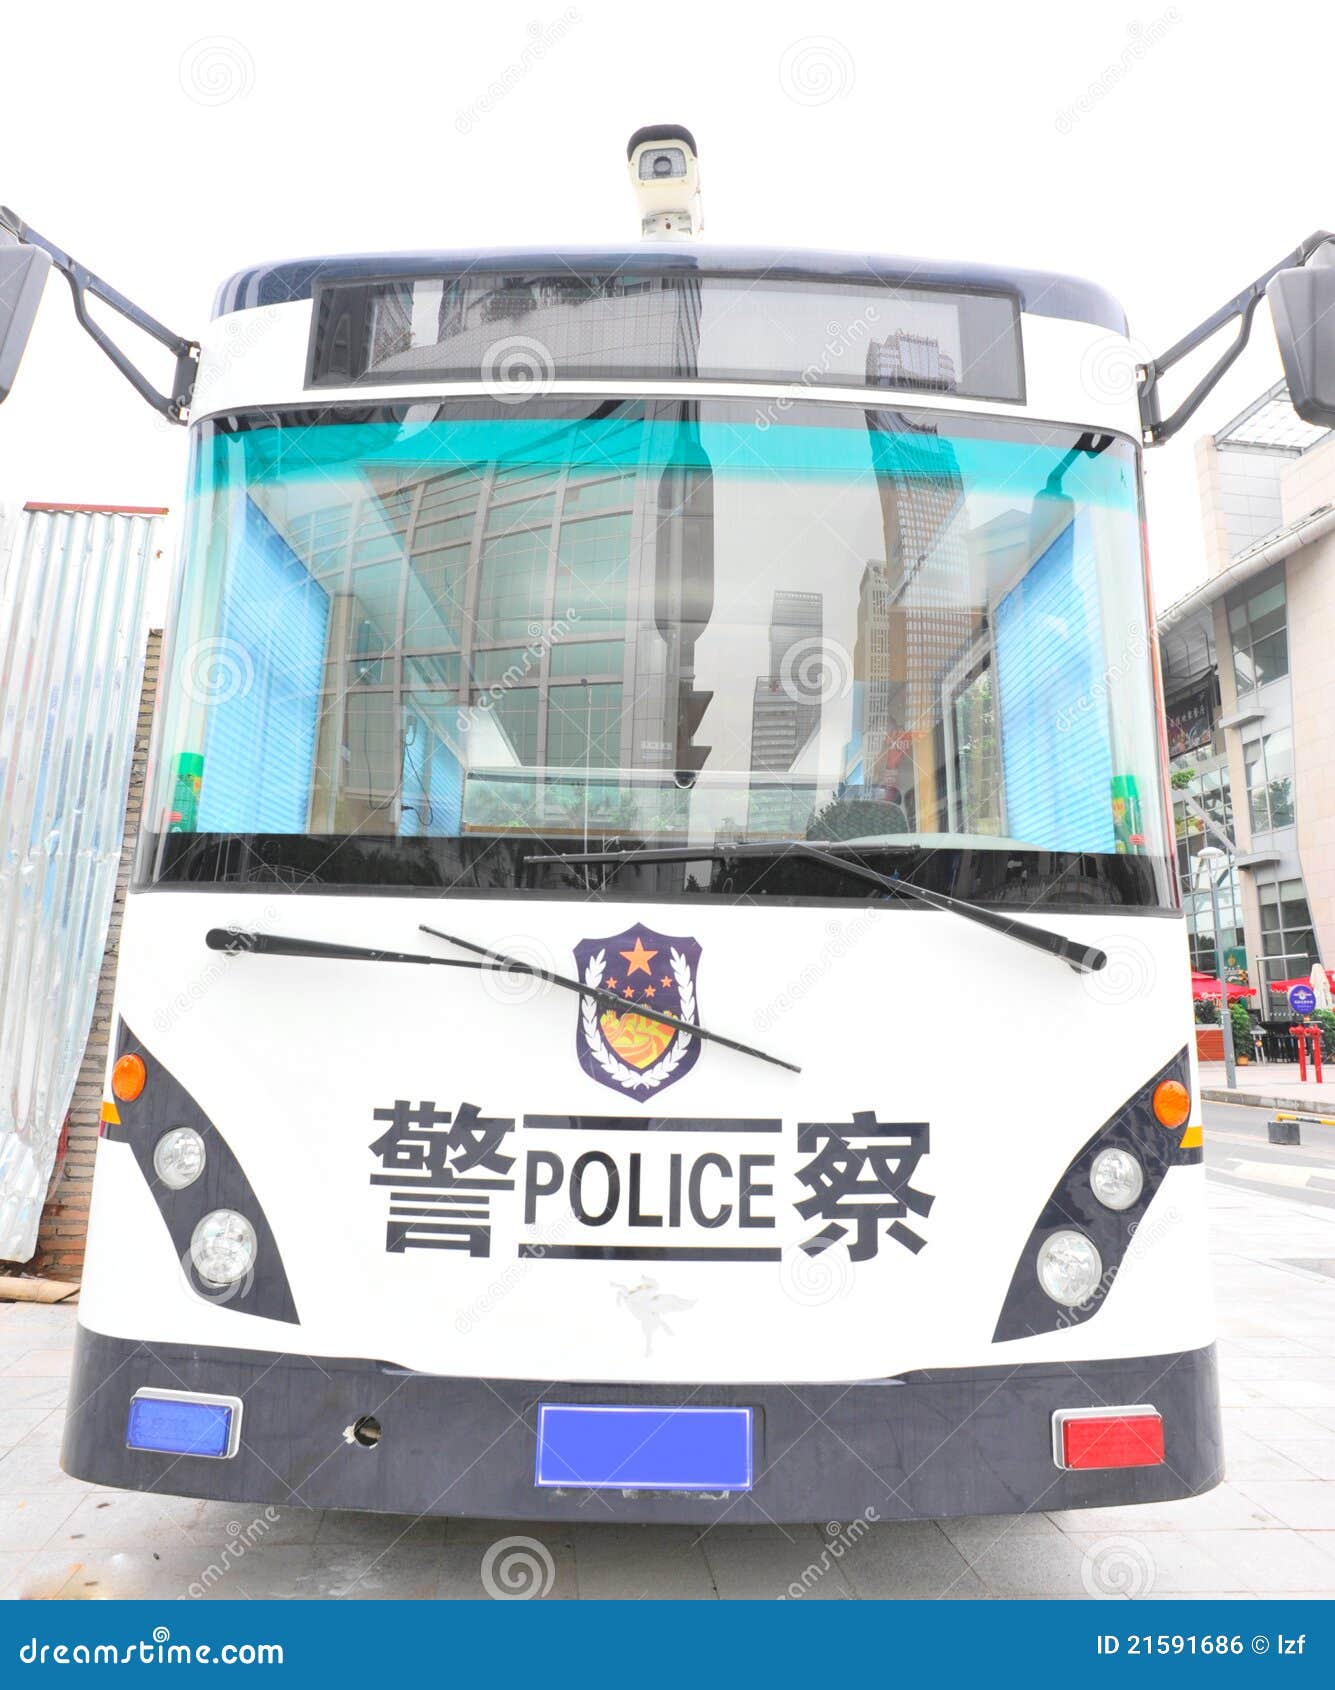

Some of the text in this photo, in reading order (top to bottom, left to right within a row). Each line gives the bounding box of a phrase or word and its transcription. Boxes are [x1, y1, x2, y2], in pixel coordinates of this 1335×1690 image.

[368, 1100, 936, 1263] 警 POLICE 察
